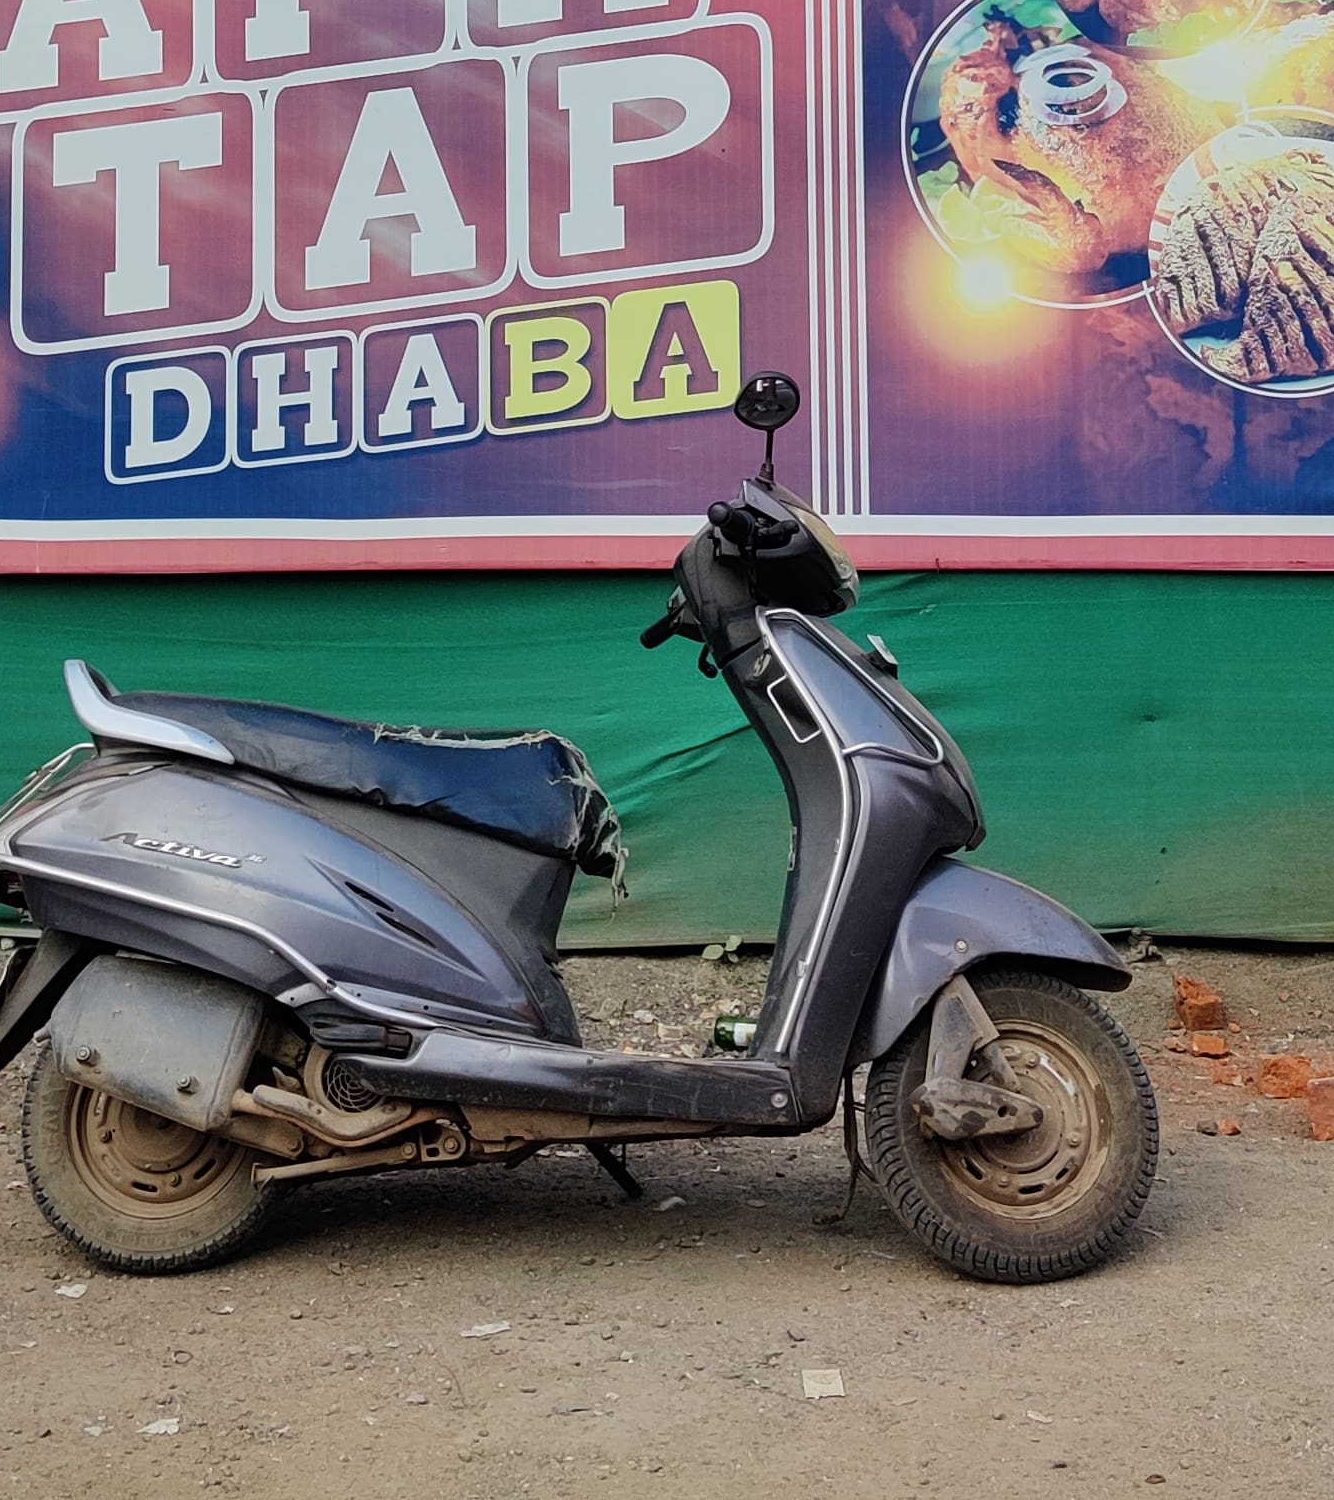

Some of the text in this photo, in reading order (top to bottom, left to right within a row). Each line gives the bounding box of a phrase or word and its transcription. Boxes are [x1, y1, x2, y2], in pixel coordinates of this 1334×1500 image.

[52, 53, 732, 317] TAP
[123, 301, 720, 469] DHABA
[99, 831, 244, 869] Activa
